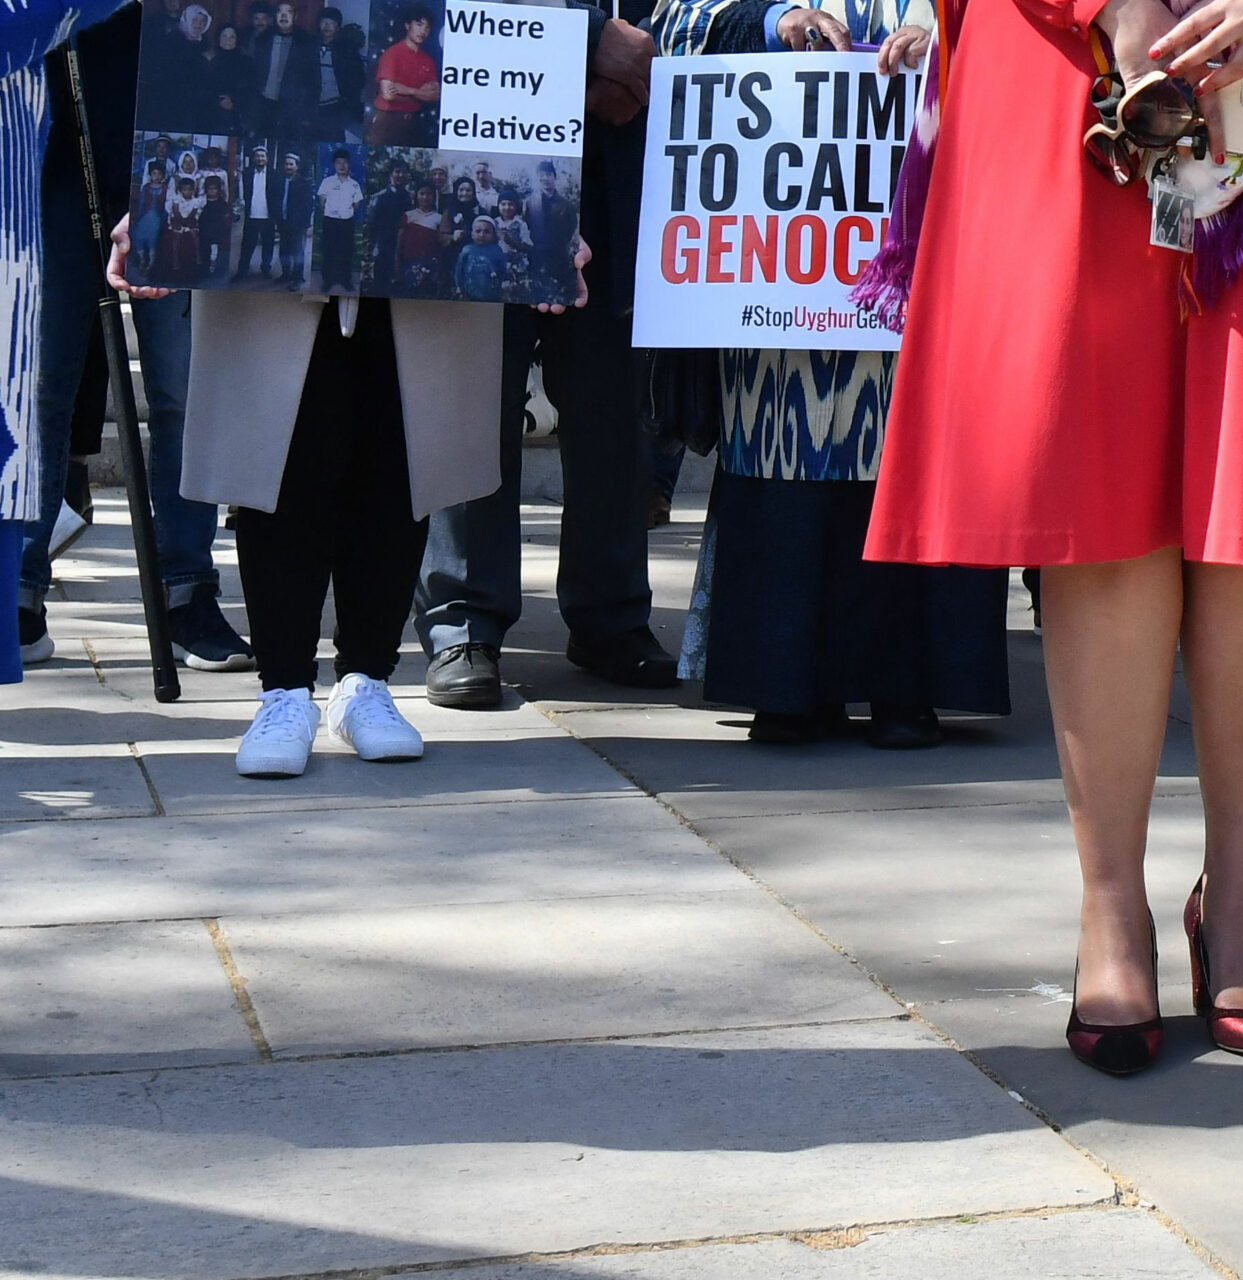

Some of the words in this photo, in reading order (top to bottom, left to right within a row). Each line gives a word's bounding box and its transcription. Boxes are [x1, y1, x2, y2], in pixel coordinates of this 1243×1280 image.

[447, 9, 544, 39] Where
[443, 66, 490, 87] are
[500, 70, 544, 96] my
[669, 71, 773, 140] IT'S
[795, 71, 922, 141] TIM
[441, 113, 582, 143] relatives?
[664, 142, 739, 212] TO
[660, 214, 890, 286] GENOC
